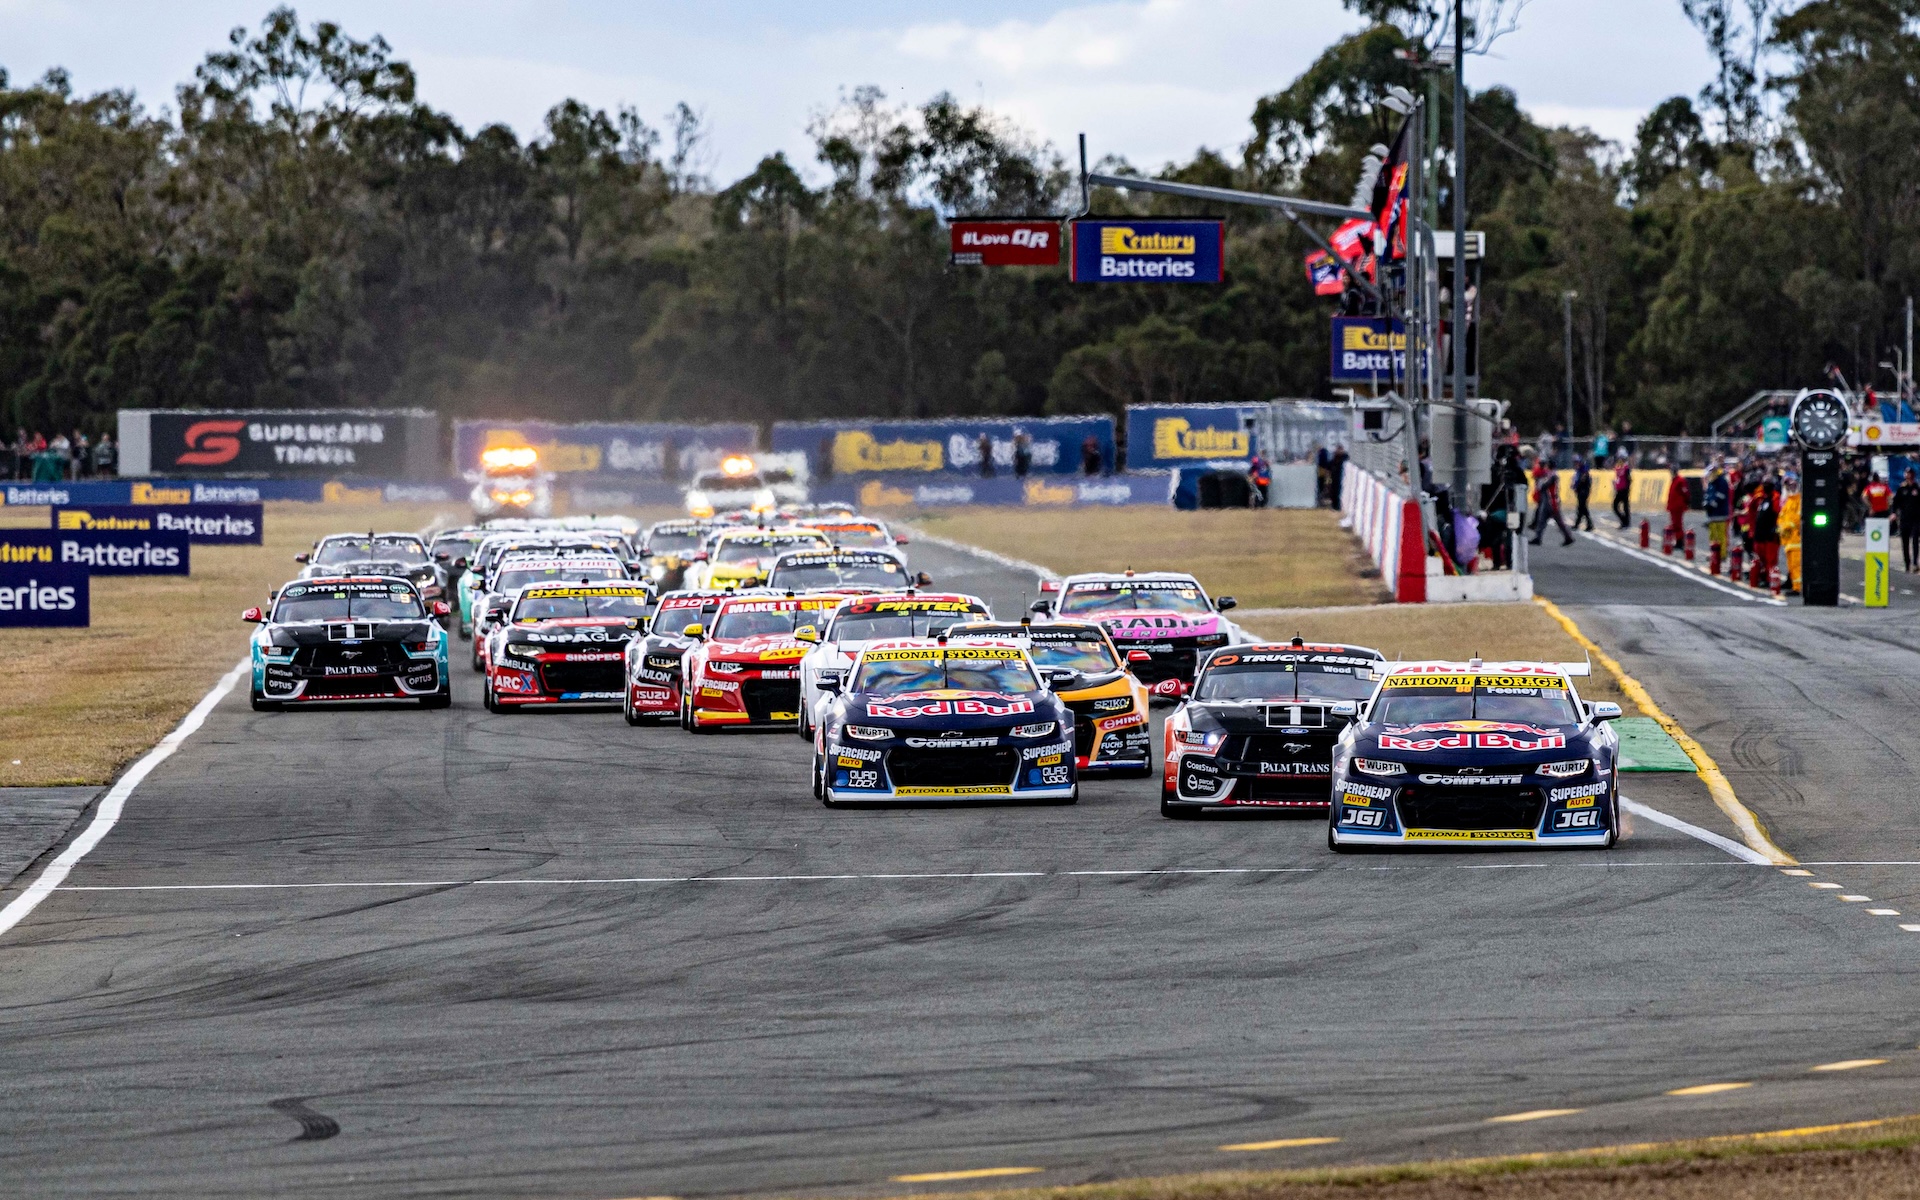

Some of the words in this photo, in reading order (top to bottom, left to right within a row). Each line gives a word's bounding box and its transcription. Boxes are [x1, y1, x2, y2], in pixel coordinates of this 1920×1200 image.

[962, 232, 1009, 246] #Love
[1101, 227, 1195, 254] Century
[1101, 257, 1195, 277] Batteries
[8, 487, 70, 504] Batteries
[194, 484, 259, 503] Batteries
[61, 540, 180, 566] Batteries
[307, 585, 337, 593] NTK
[1110, 581, 1196, 590] BATTERIES
[525, 588, 647, 598] Hydraulink
[665, 599, 715, 608] 1300
[728, 602, 776, 614] MAKE
[780, 602, 797, 611] IT
[875, 602, 972, 612] PIRTEK
[565, 653, 622, 662] SINOPEC
[866, 651, 939, 661] NATIONAL
[947, 649, 1018, 659] STORAGE
[1242, 654, 1302, 662] TRUCK
[1308, 655, 1376, 666] ASSIST
[325, 666, 349, 676] PALM
[349, 665, 378, 675] TRANS
[761, 670, 790, 679] MAKE
[1323, 665, 1352, 674] Wood
[269, 680, 292, 690] OPTUS
[409, 674, 432, 685] OPTUS
[1388, 677, 1471, 687] NATIONAL
[1480, 676, 1560, 688] STORAGE
[637, 690, 670, 700] ISUZU
[1487, 687, 1538, 696] Feeney
[867, 701, 950, 718] Red
[955, 700, 1035, 716] Bull
[1094, 698, 1127, 710] SEIKO
[1115, 714, 1141, 726] HINO
[1284, 706, 1301, 724] 1
[1100, 740, 1124, 750] FUCHS
[1380, 734, 1472, 750] Red
[1476, 733, 1565, 750] Bull
[840, 758, 860, 766] AUTO
[1039, 756, 1059, 764] AUTO
[1042, 766, 1069, 777] QUAD
[1260, 762, 1291, 773] PALM
[1292, 762, 1330, 774] TRANS
[849, 770, 878, 780] QUAD
[1042, 775, 1070, 785] LOCK
[848, 780, 877, 788] LOCK
[1346, 795, 1369, 804] AUTO
[1568, 798, 1592, 807] AUTO
[1341, 809, 1383, 827] JGI
[1556, 810, 1598, 828] JGI
[1474, 831, 1532, 839] STORAGE
